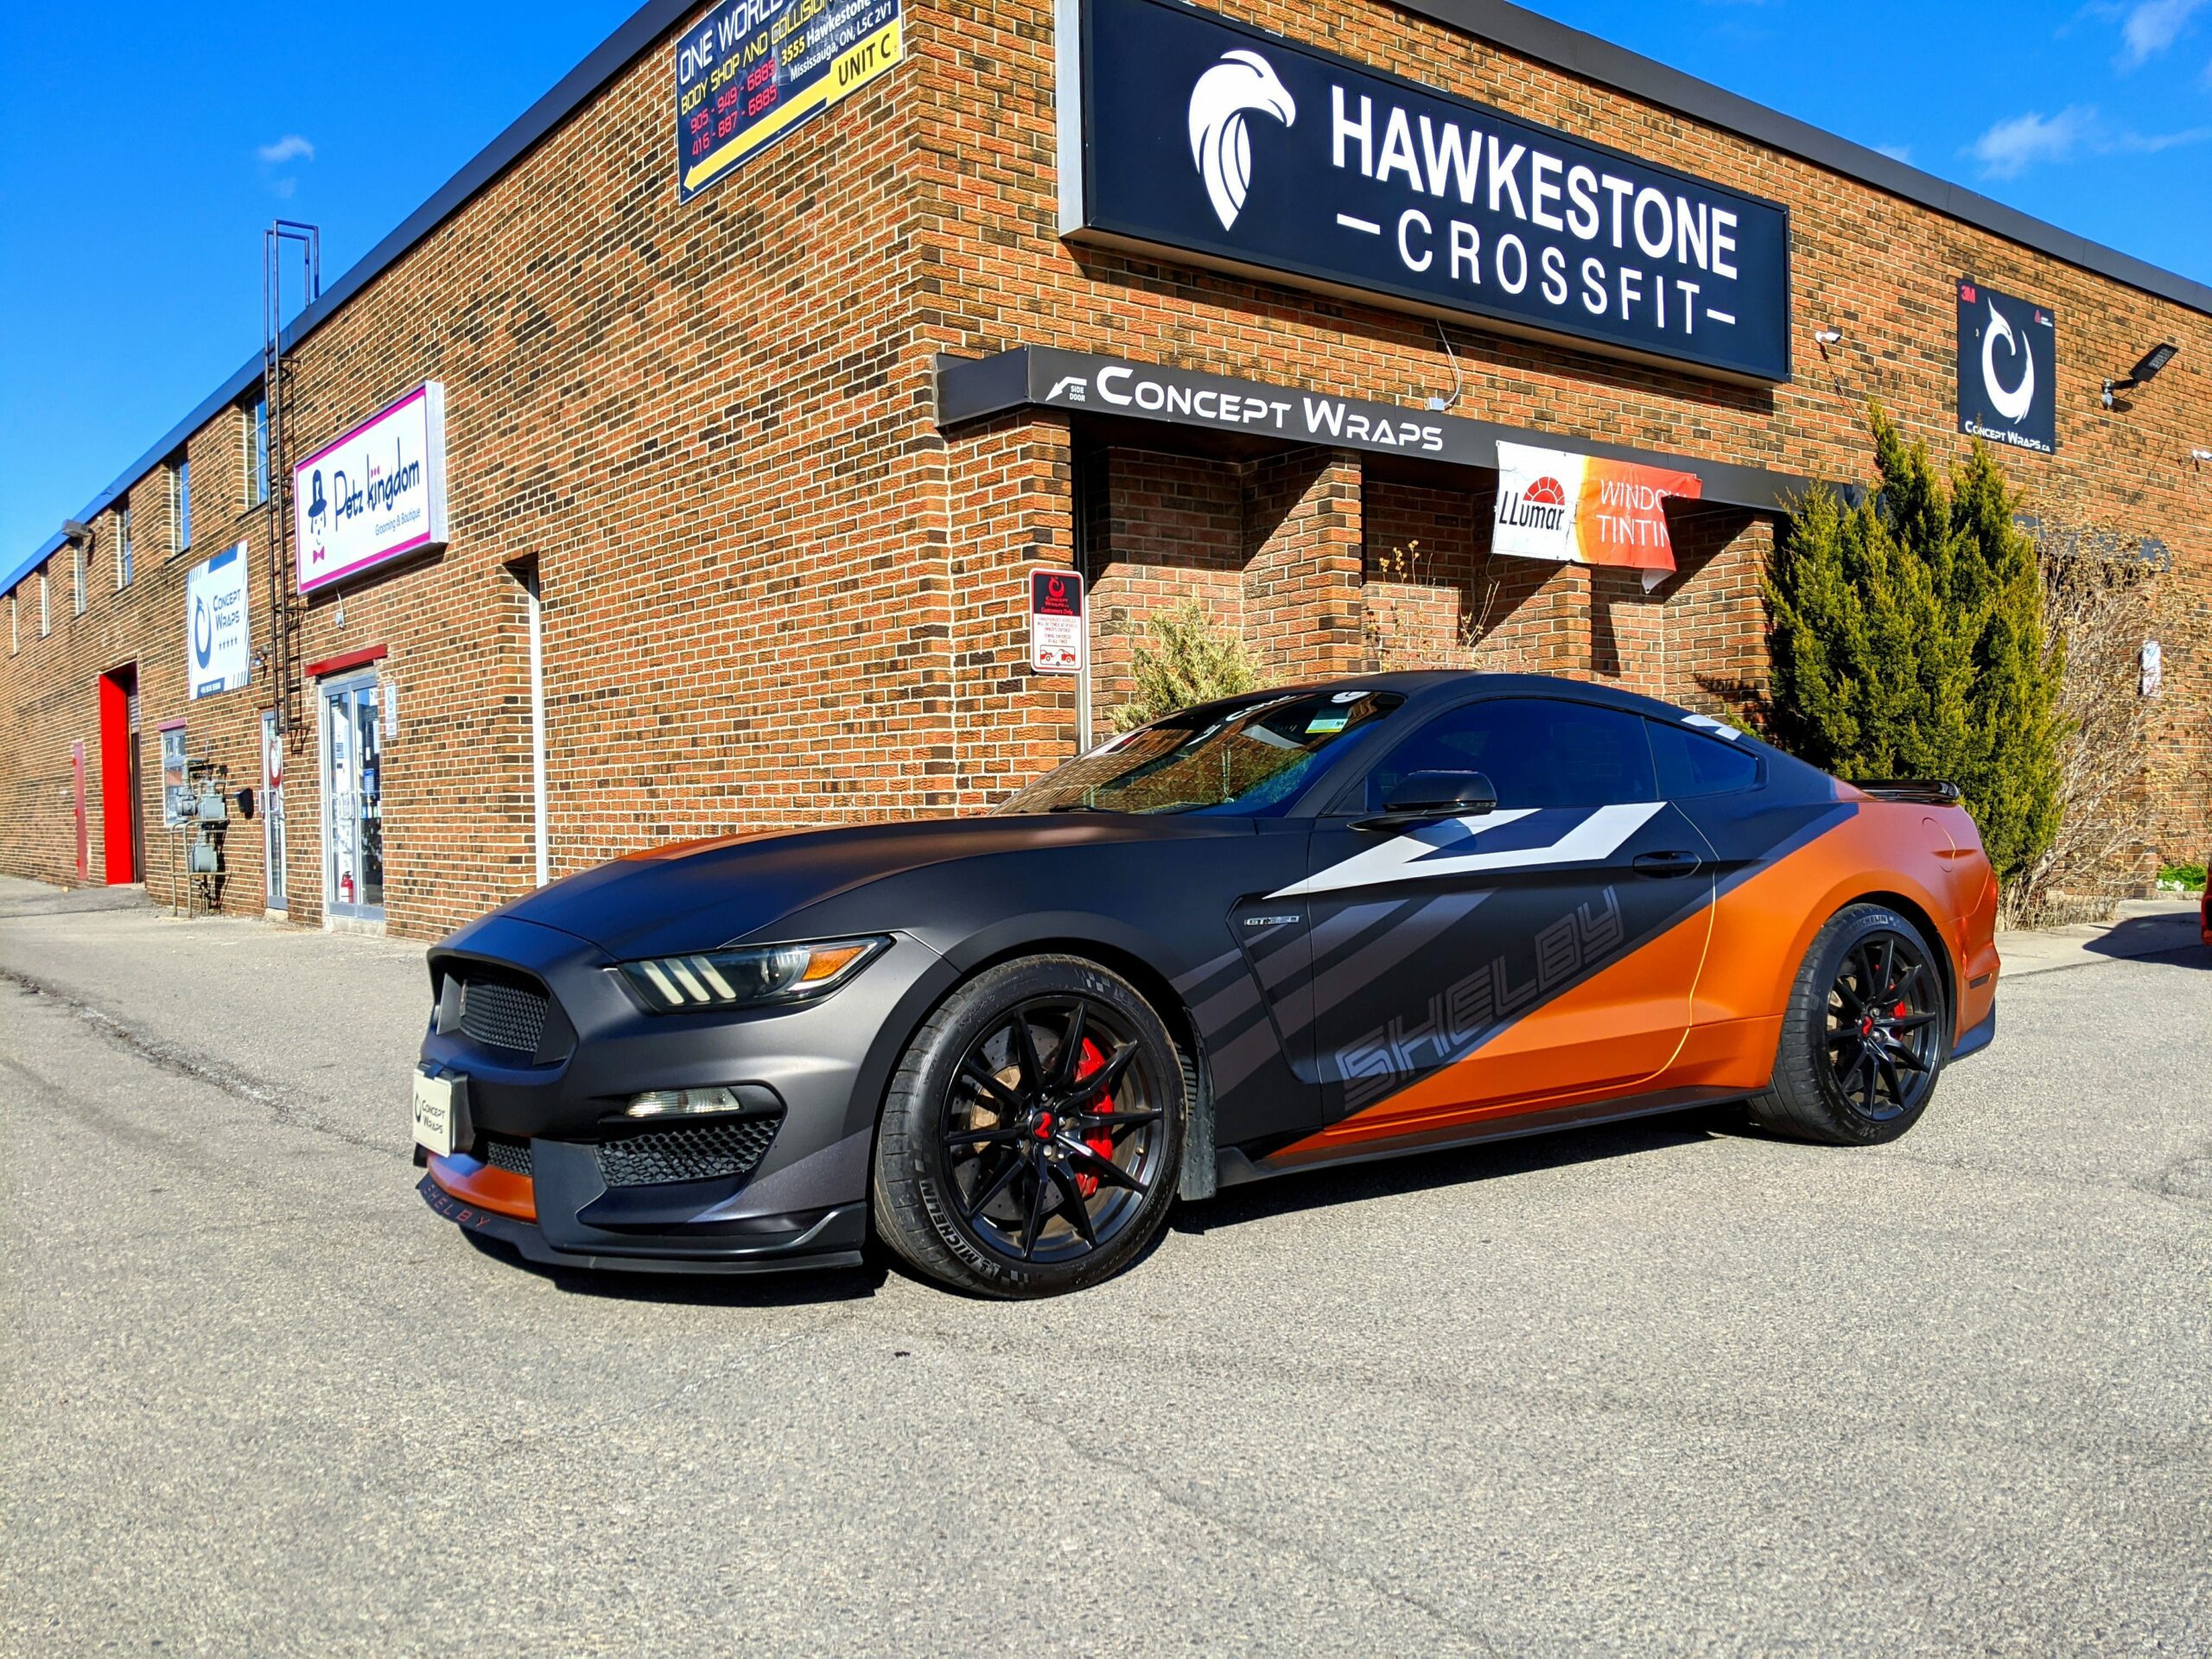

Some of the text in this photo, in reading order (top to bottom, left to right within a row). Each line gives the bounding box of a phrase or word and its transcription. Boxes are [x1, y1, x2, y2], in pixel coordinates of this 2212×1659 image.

[680, 29, 713, 86] ONE
[781, 35, 805, 67] 3555
[790, 0, 892, 82] Mississauga, ON, L5C 2V1
[838, 33, 891, 86] UNIT C
[681, 77, 708, 117] BODY
[710, 53, 740, 92] SHOP
[742, 31, 768, 68] AND
[690, 57, 776, 135] 905 949 6885
[692, 83, 777, 156] 416 887 6885
[1332, 84, 1738, 281] HAWKESTONE
[1397, 207, 1701, 335] CROSSFIT
[1961, 285, 1976, 303] 3M
[1069, 393, 1086, 403] DOOR
[1071, 385, 1084, 394] SIDE
[1096, 365, 1444, 452] CONCEPT WRAPS
[334, 436, 420, 532] Petz kingdom
[1600, 479, 1688, 512] WINDO
[1498, 491, 1565, 531] LLumar
[1596, 514, 1670, 548] TINTIN
[213, 588, 241, 612] CONCEPT
[215, 610, 240, 631] WRAPS
[1336, 884, 1624, 1112] SHELBY
[422, 1099, 446, 1119] CONCEPT
[423, 1114, 443, 1135] WRAPS
[919, 1178, 982, 1266] MICHELIN
